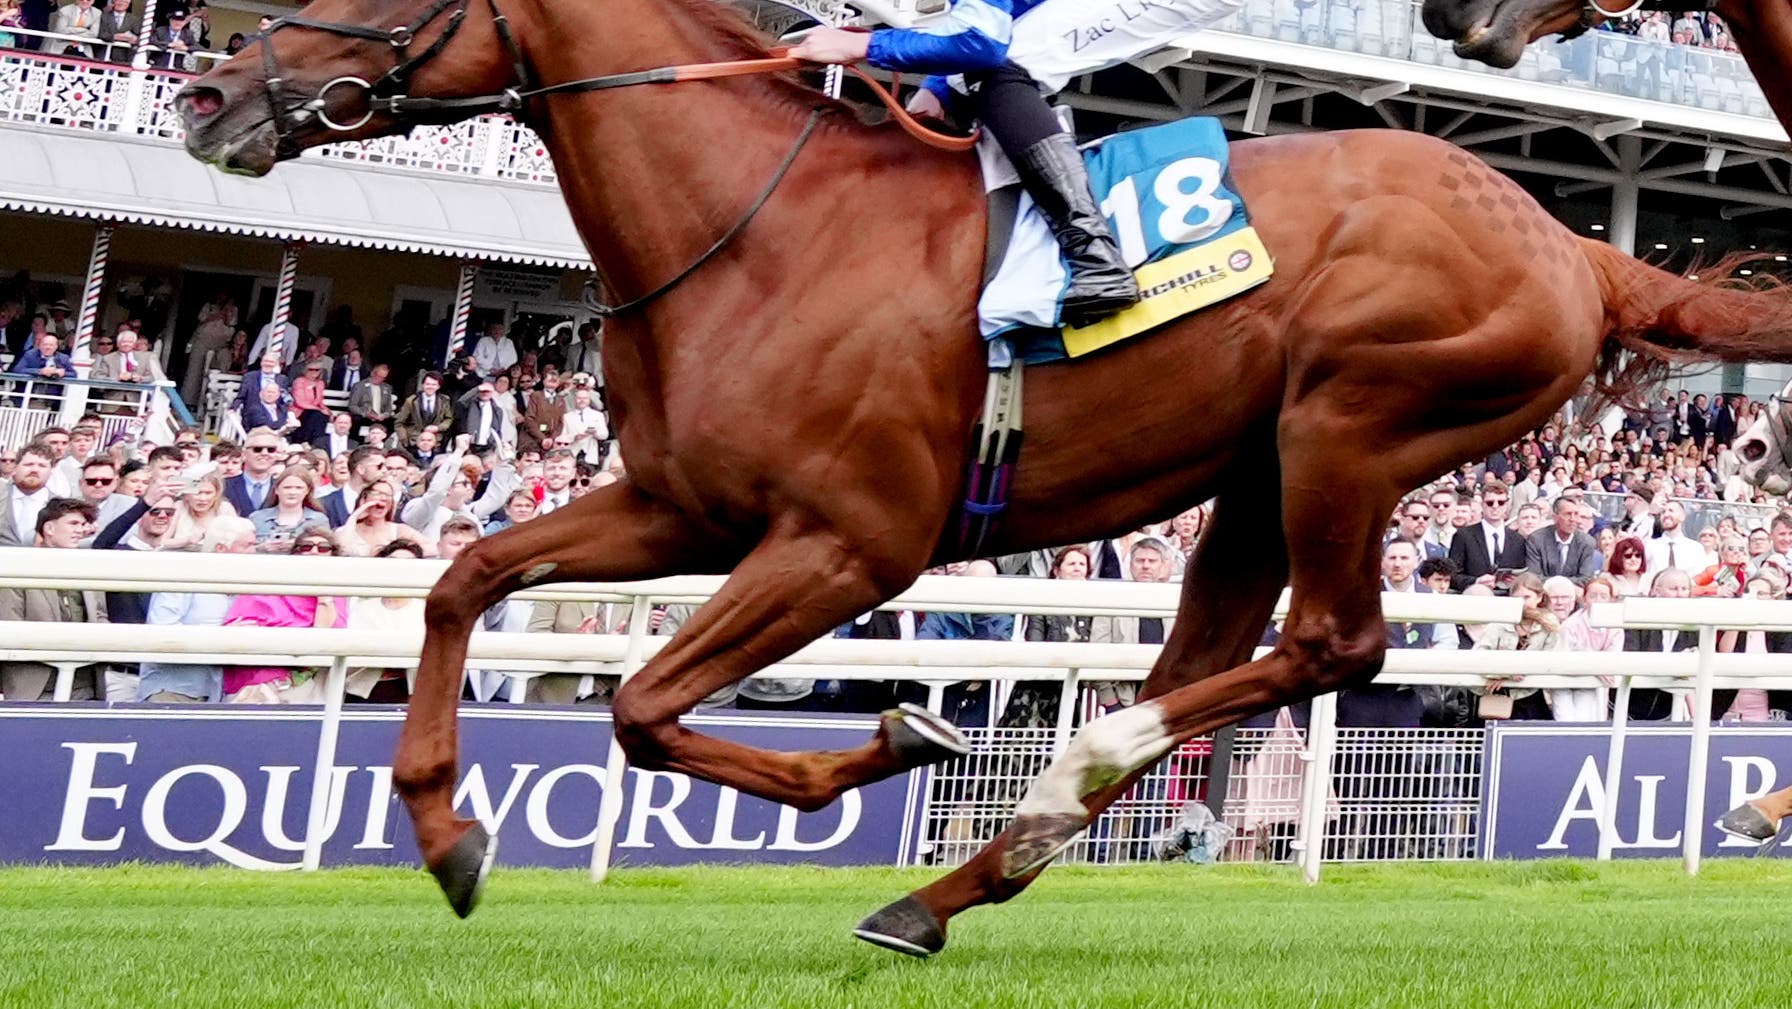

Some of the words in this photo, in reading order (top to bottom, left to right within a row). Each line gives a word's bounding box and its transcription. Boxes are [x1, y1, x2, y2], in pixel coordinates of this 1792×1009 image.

[1063, 18, 1116, 53] Zac
[1101, 157, 1233, 268] 18
[1137, 265, 1224, 302] RCHILL
[1181, 271, 1227, 293] TYRES
[43, 741, 862, 872] EQUIWORLD
[1536, 754, 1682, 850] AL
